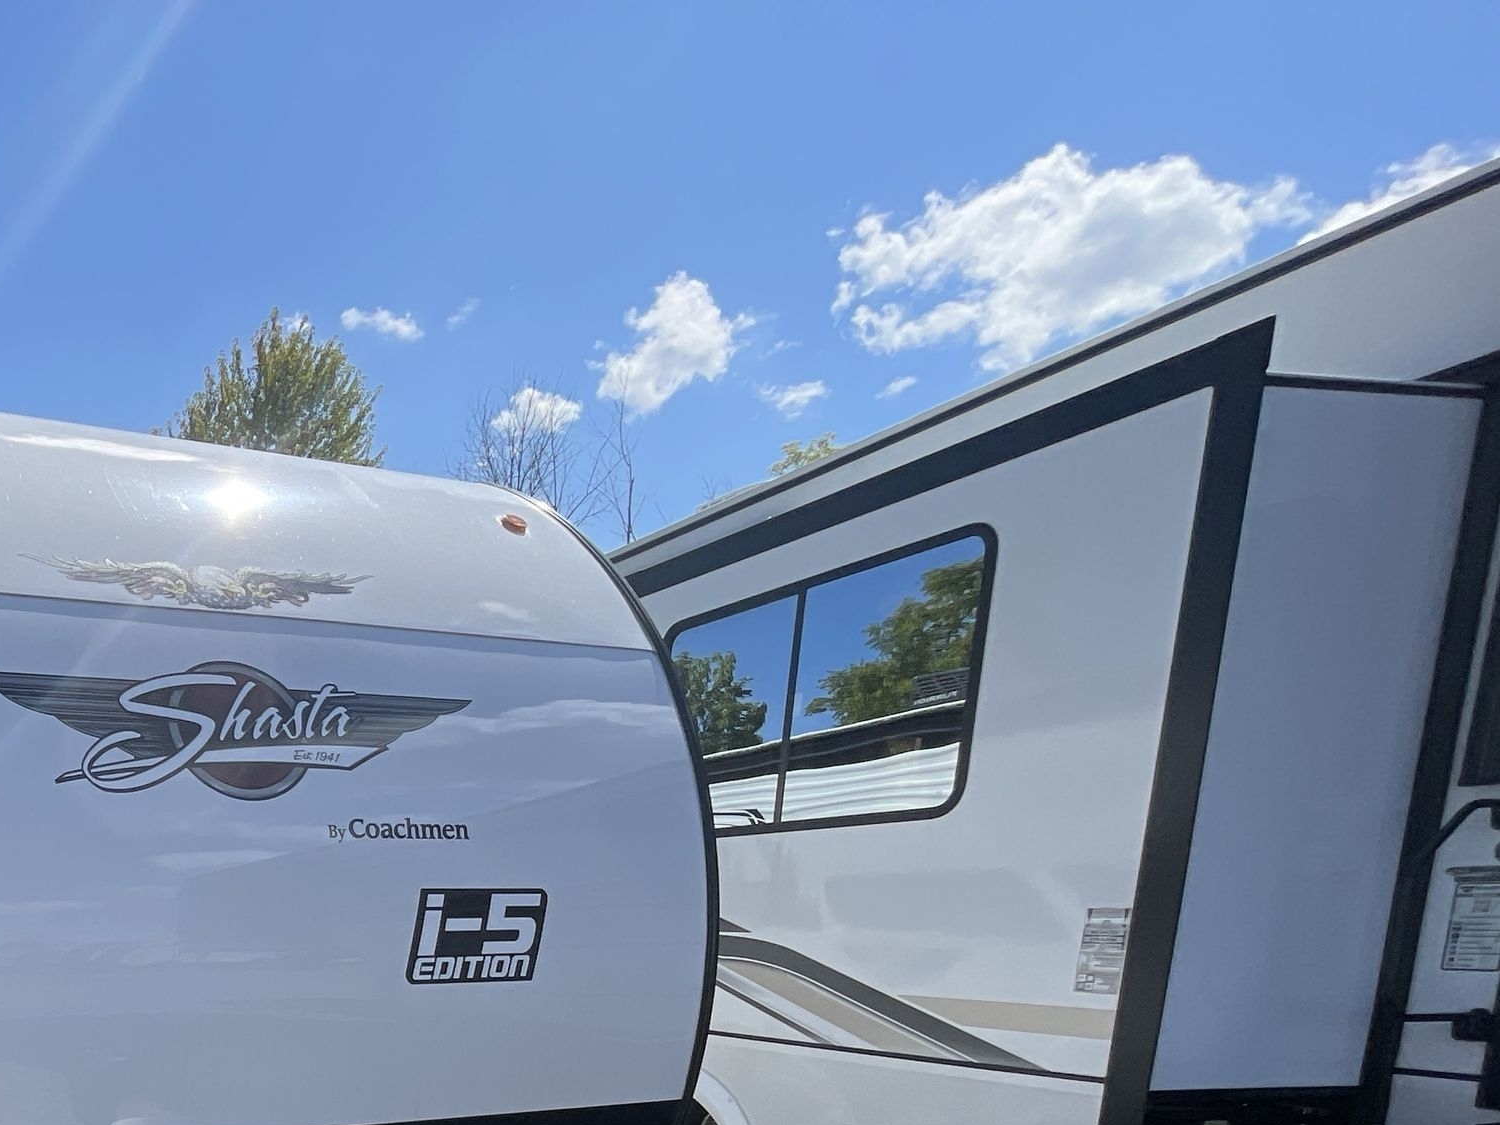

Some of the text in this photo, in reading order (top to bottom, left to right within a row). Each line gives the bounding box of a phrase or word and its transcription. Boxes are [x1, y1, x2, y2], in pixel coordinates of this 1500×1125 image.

[81, 672, 356, 793] Shasta
[314, 751, 341, 763] 1941
[328, 817, 470, 843] By Coachmen
[417, 893, 542, 957] i-5
[412, 955, 531, 981] EDITION
